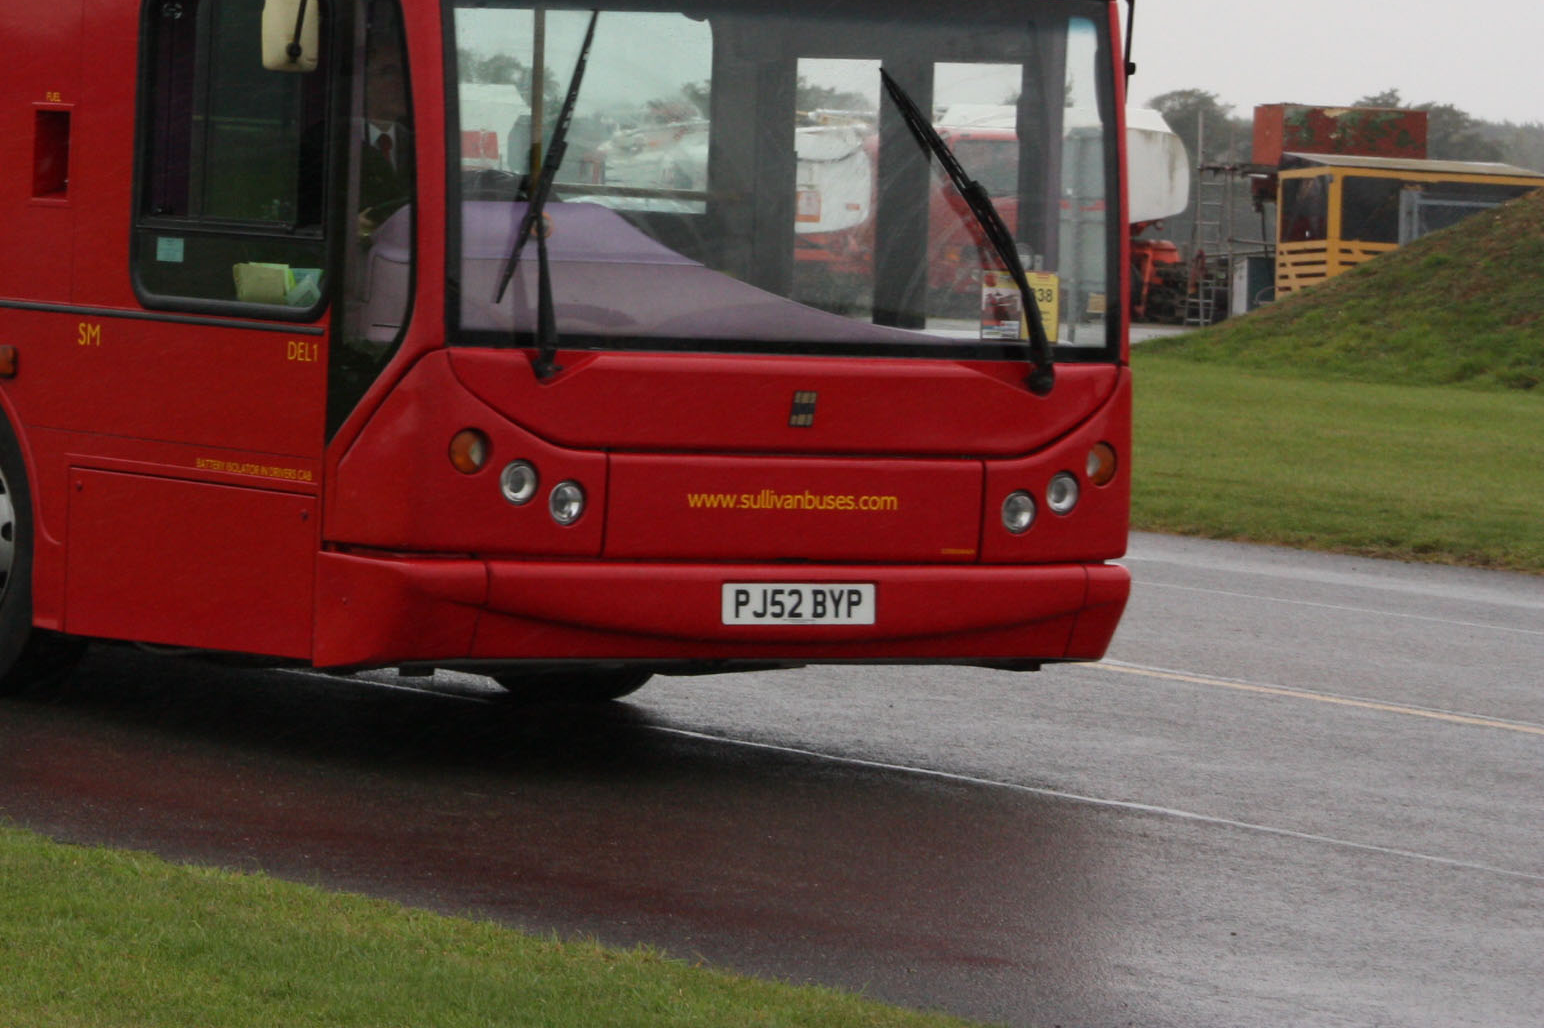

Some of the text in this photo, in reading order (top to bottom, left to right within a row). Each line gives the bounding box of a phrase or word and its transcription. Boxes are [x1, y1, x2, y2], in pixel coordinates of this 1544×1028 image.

[78, 322, 101, 347] SM
[287, 340, 318, 362] DEL1
[687, 489, 898, 511] www.sullivanbuses.com
[734, 588, 862, 619] PJ52 BYP
